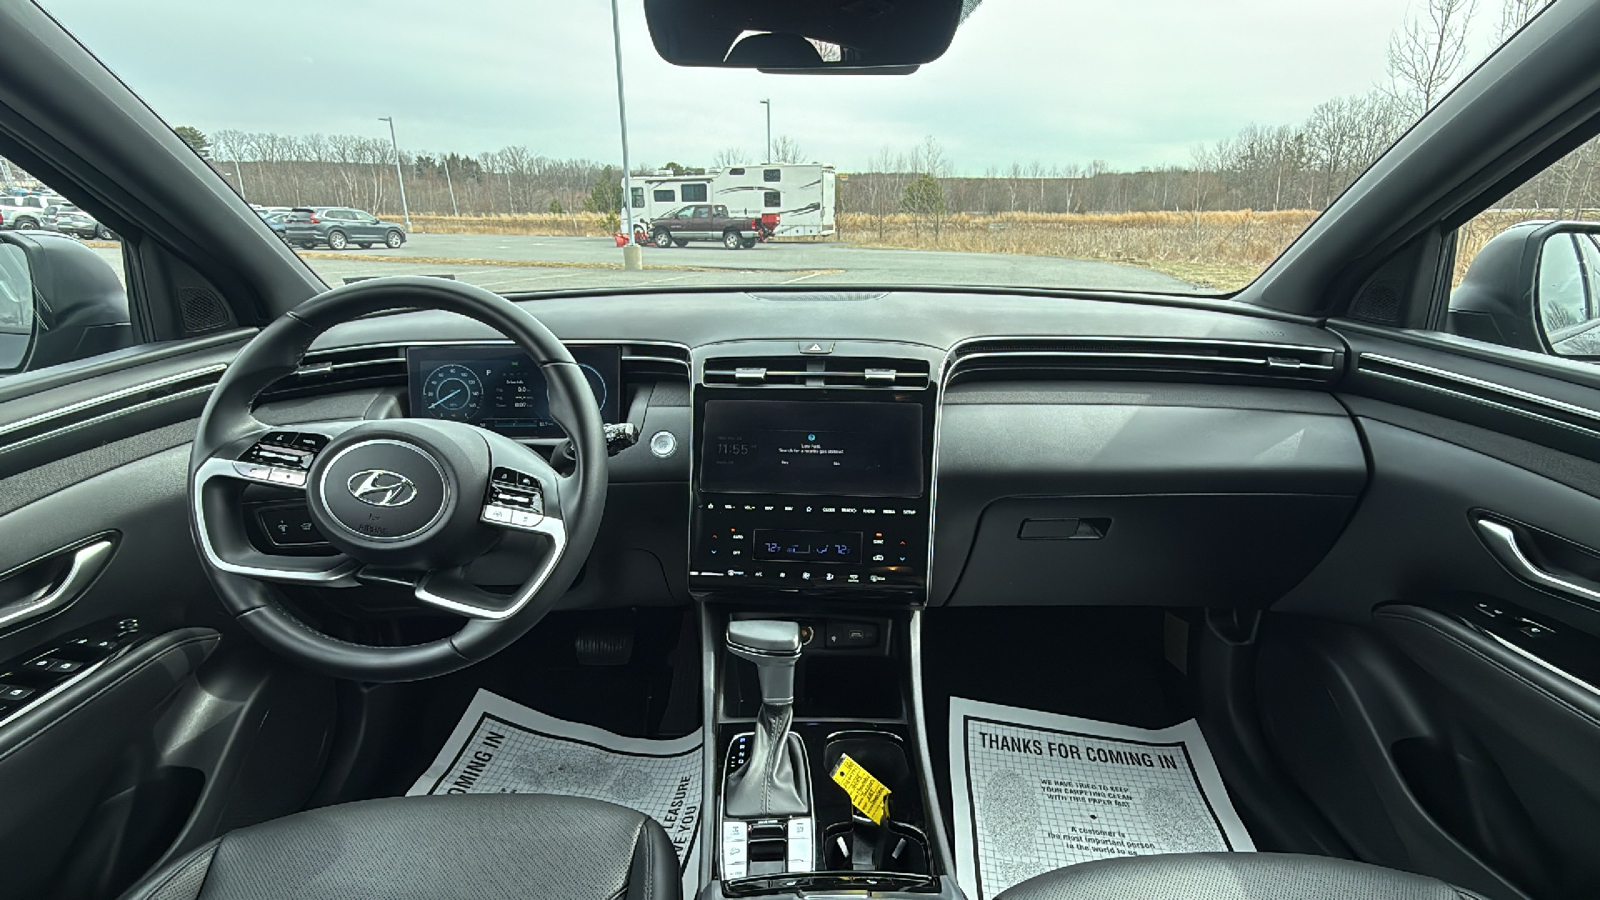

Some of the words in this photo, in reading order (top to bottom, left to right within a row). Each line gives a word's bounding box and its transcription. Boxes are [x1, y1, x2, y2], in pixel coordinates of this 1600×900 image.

[717, 443, 748, 455] 11:55
[979, 732, 1042, 756] THANKS
[1048, 742, 1081, 760] FOR
[1086, 747, 1154, 768] COMING
[1157, 754, 1178, 769] IN
[447, 751, 493, 794] OMING
[482, 731, 505, 748] IN
[1064, 788, 1106, 798] CARPETING
[663, 775, 692, 829] LEASURE
[678, 805, 697, 833] YOU
[1079, 828, 1116, 837] customer
[1084, 836, 1125, 847] important
[1092, 845, 1115, 854] world
